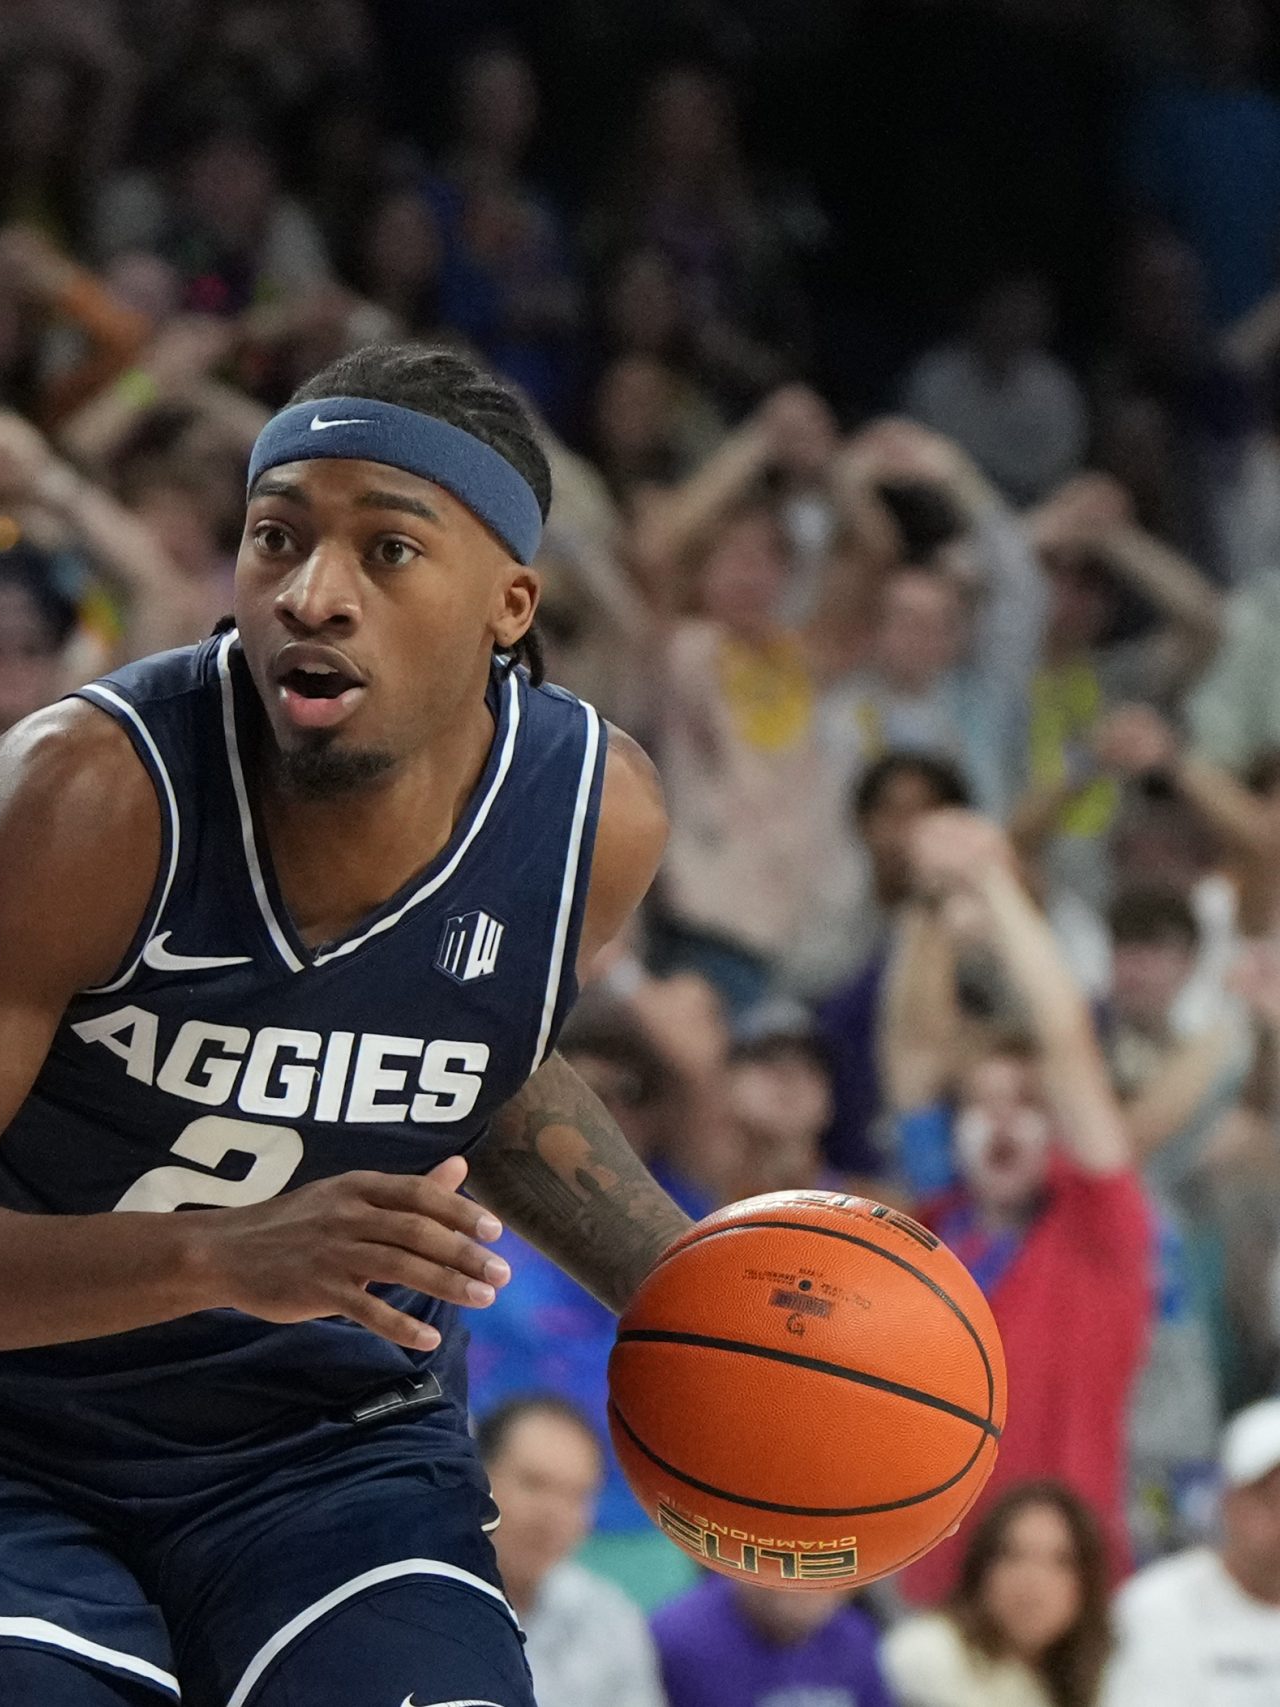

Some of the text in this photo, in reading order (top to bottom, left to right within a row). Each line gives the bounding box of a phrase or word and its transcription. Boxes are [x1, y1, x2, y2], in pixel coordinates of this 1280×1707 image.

[70, 1005, 490, 1123] AGGIES
[112, 1115, 304, 1213] 2
[657, 1501, 858, 1580] ELITE
